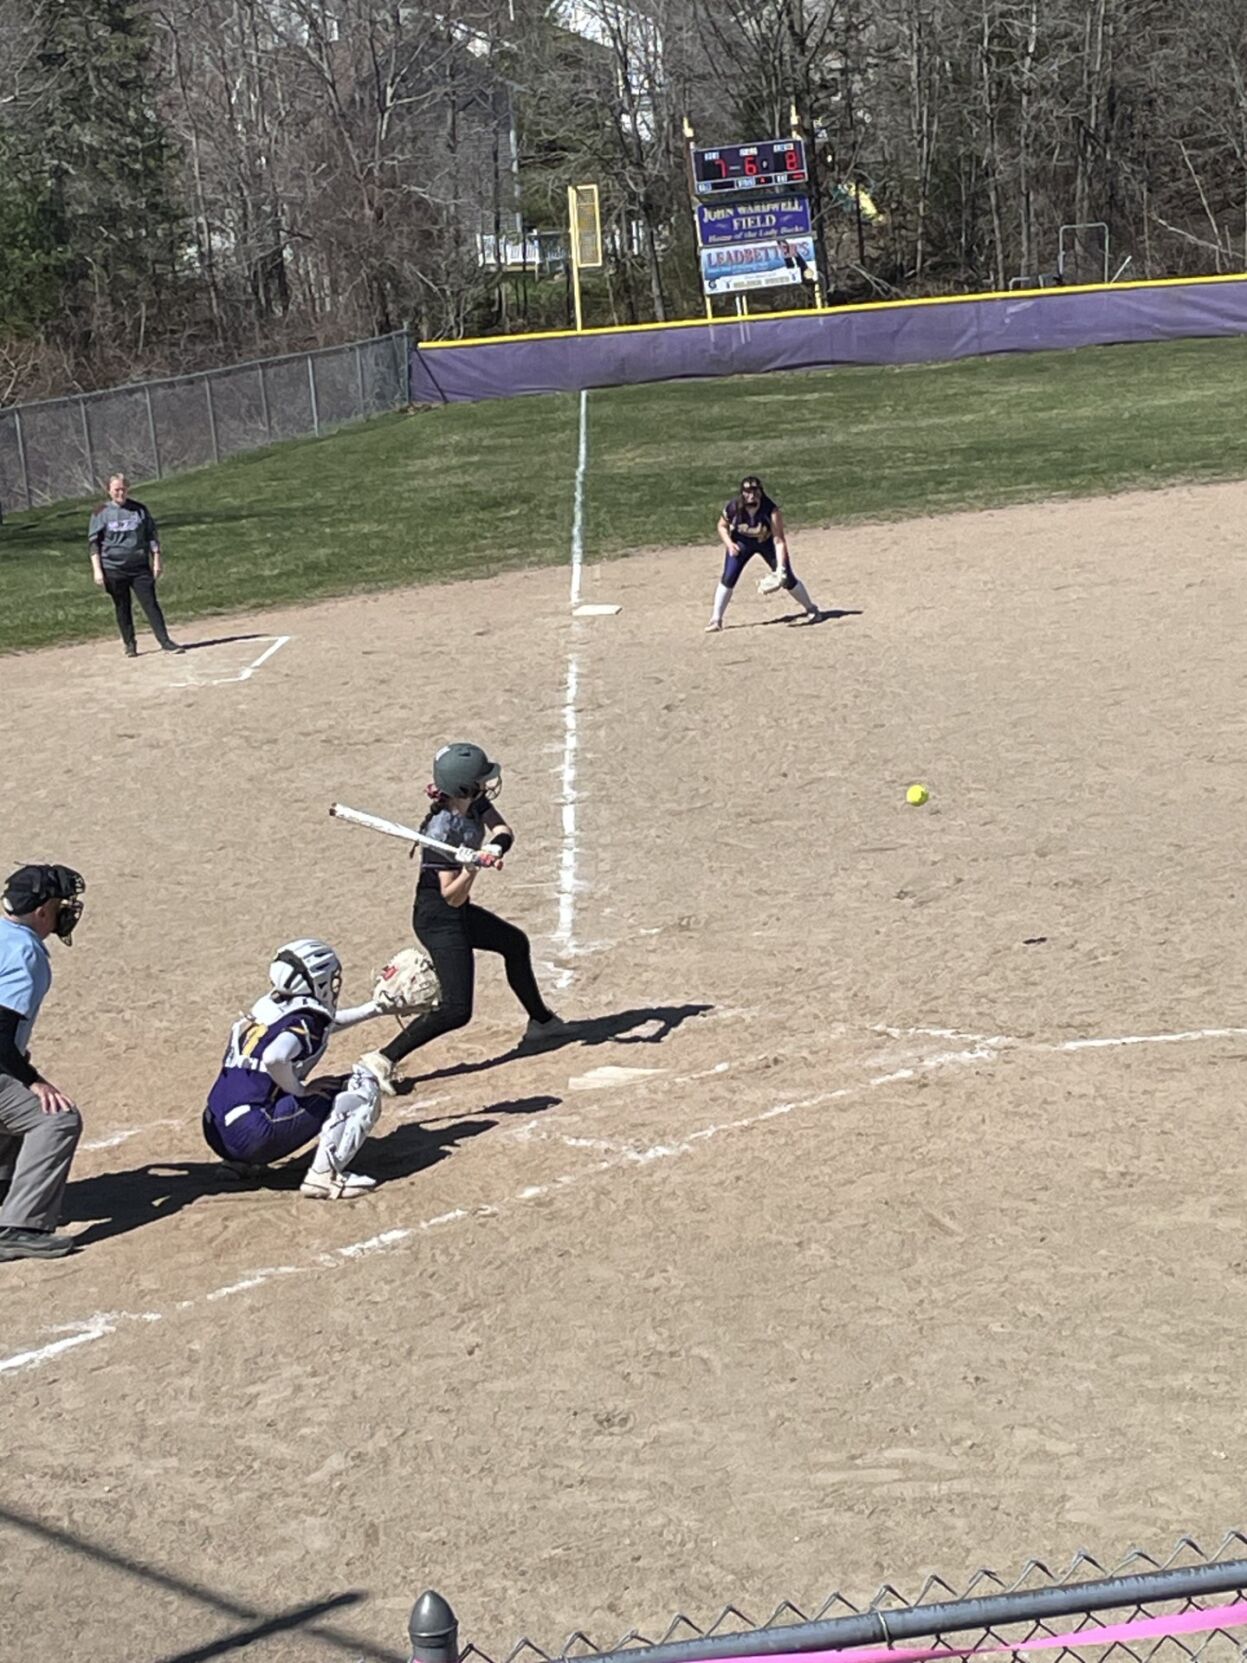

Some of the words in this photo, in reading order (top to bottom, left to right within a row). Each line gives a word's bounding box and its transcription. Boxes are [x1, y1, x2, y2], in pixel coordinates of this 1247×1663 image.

[715, 159, 728, 178] 7
[744, 156, 757, 175] 6
[785, 152, 798, 170] 8
[703, 207, 734, 223] JOHN
[732, 214, 776, 231] FIELD
